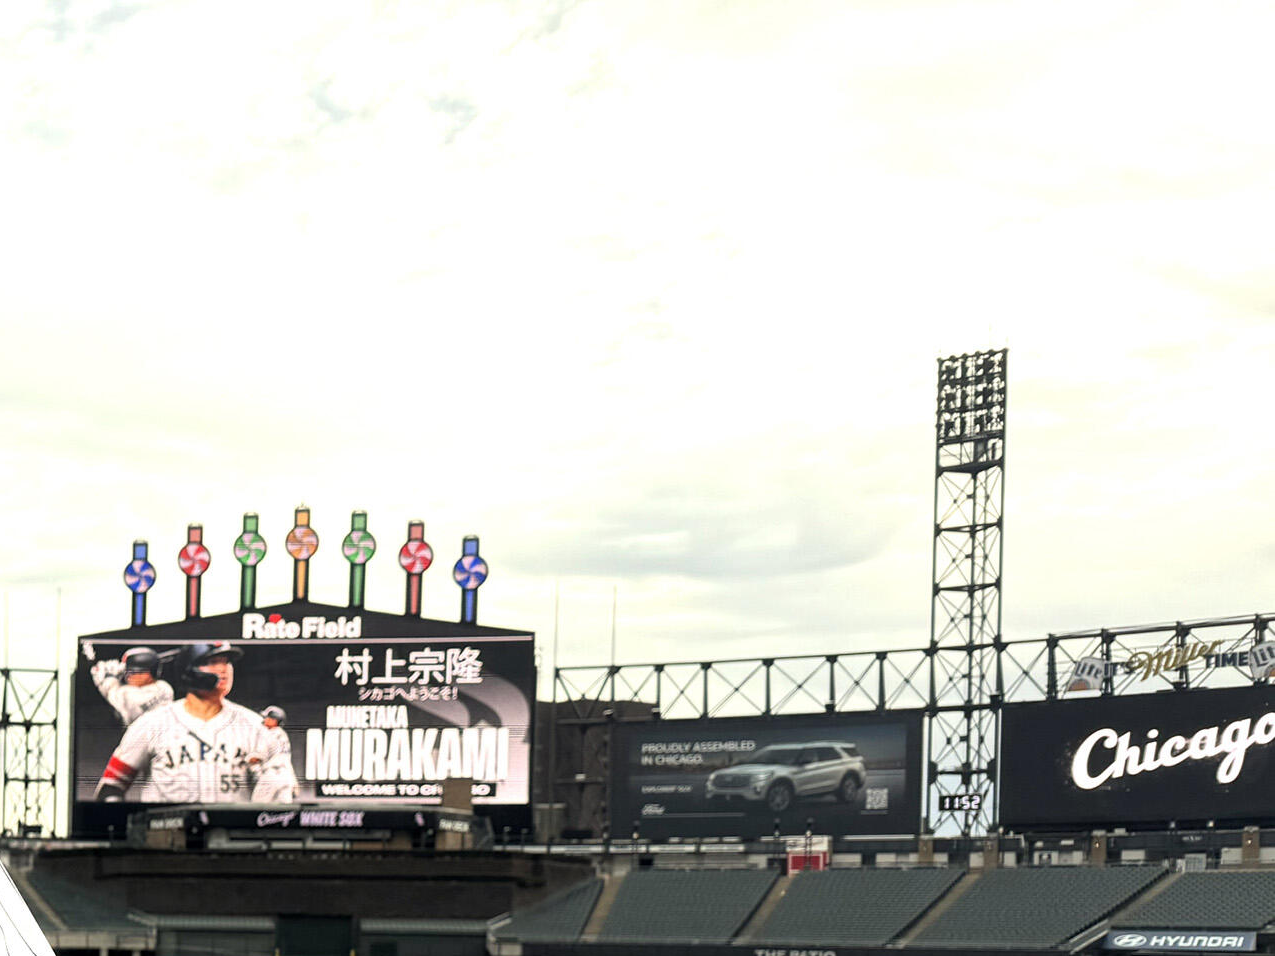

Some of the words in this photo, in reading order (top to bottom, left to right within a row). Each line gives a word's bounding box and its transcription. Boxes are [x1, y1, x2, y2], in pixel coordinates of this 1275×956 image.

[242, 612, 301, 639] Rate
[302, 616, 362, 639] Field
[334, 647, 483, 686] 村上宗隆
[1127, 640, 1225, 682] Miller
[1205, 651, 1250, 669] TIME
[327, 705, 408, 729] MUNETAKA
[305, 728, 509, 780] MURAKAMI
[641, 743, 691, 754] PROUDLY
[692, 740, 756, 752] ASSEMBLED
[1071, 711, 1275, 790] Chicago
[641, 755, 654, 766] IN
[220, 774, 239, 792] 55
[321, 784, 396, 796] WELCOME
[398, 784, 420, 796] TO
[299, 811, 337, 827] WHITE
[338, 811, 364, 827] SOX
[1149, 935, 1244, 948] HYUNDAI
